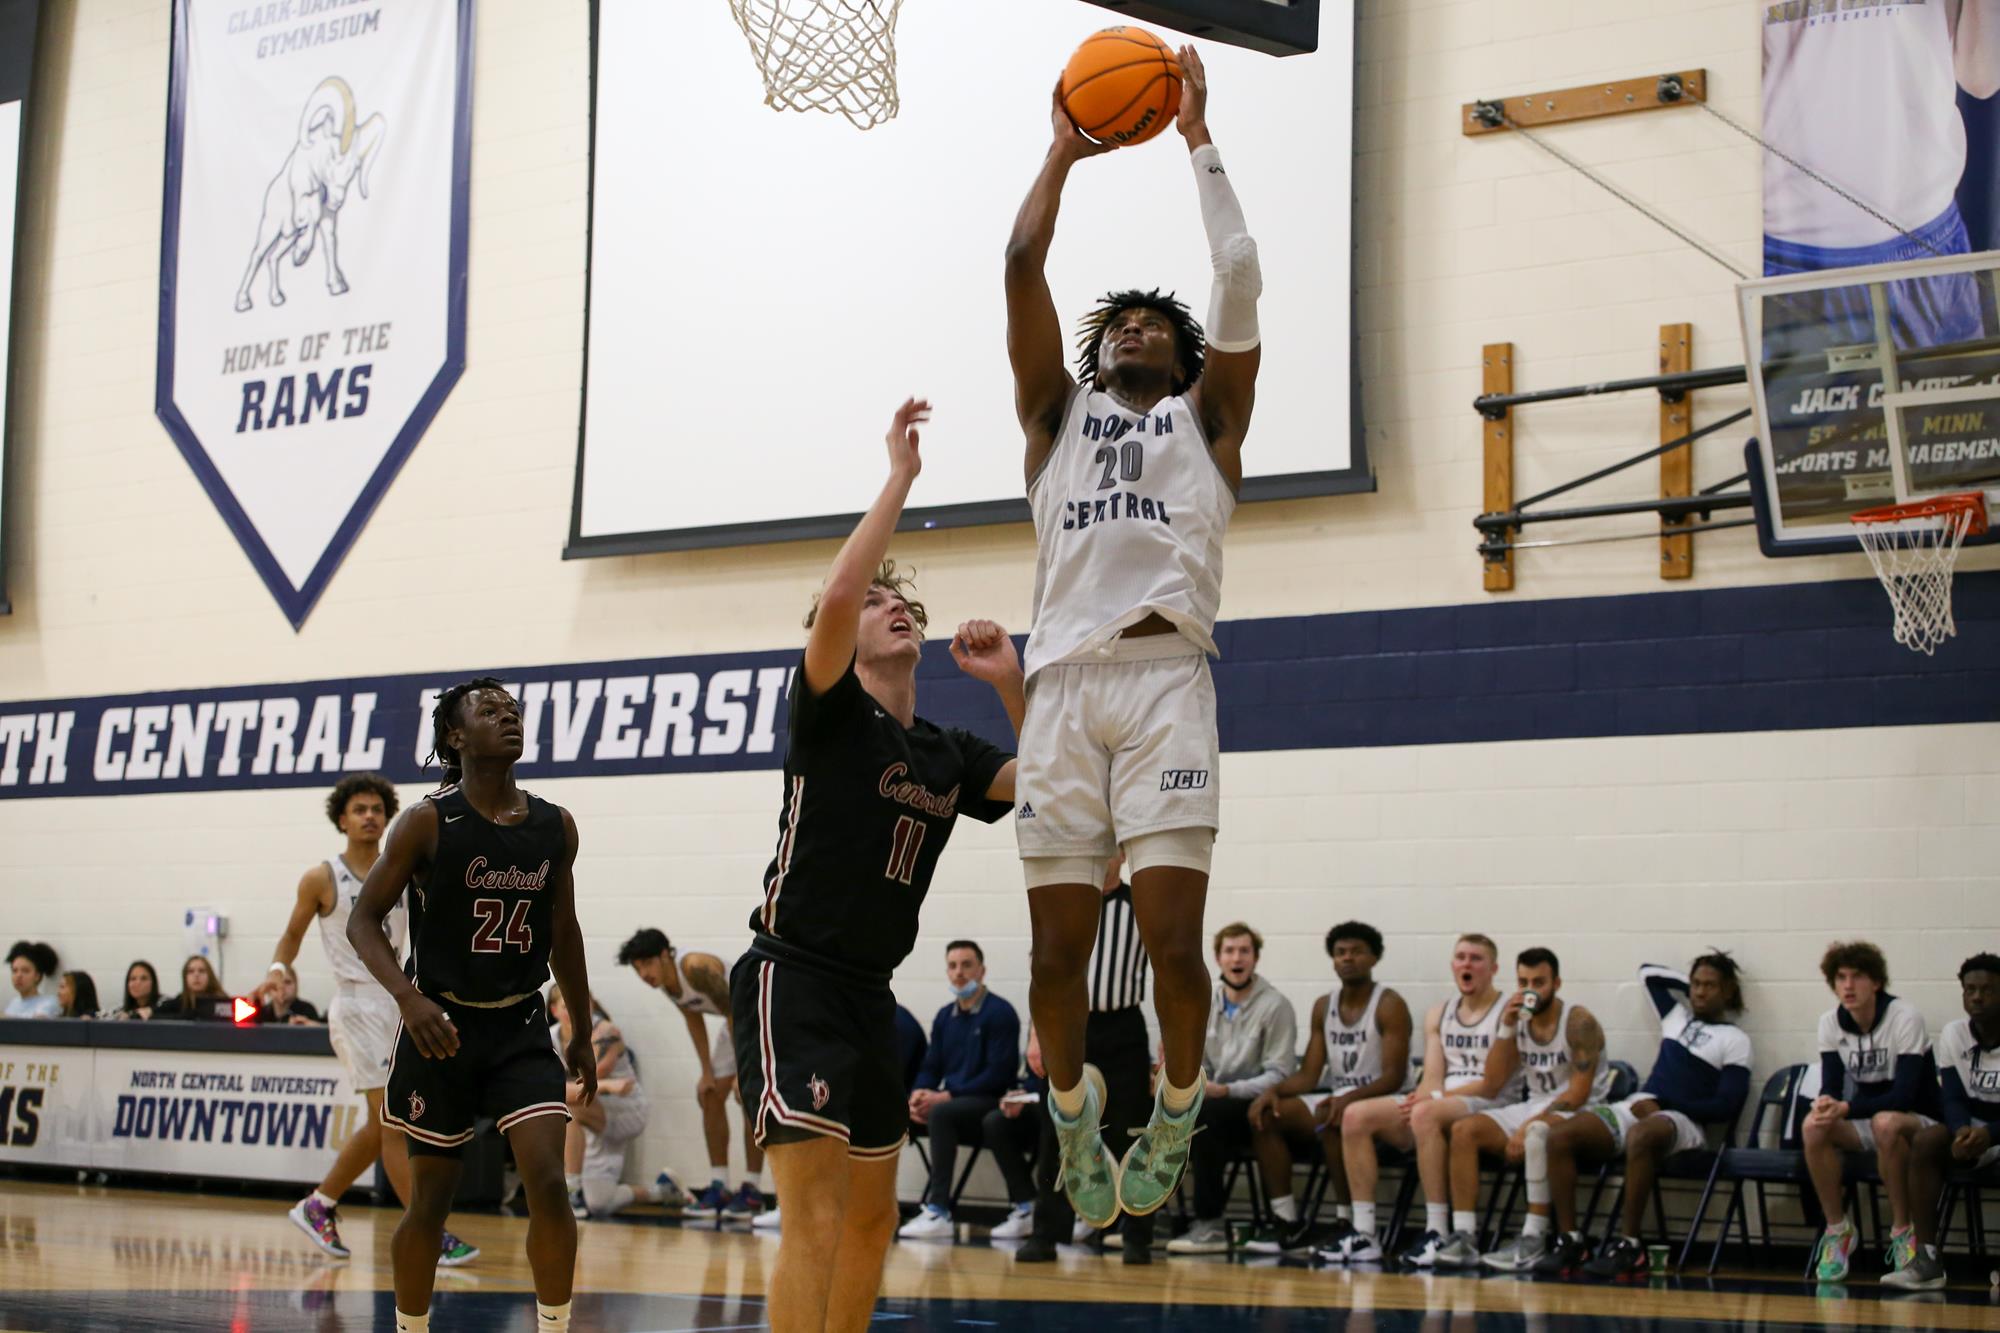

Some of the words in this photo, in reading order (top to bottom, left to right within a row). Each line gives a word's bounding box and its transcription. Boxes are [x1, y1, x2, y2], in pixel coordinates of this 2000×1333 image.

[256, 8, 381, 60] GYMNASIUM
[222, 338, 289, 375] HOME
[299, 331, 330, 362] OF
[343, 321, 391, 356] THE
[236, 364, 373, 434] RAMS
[1791, 384, 1860, 414] JACK
[1082, 411, 1174, 442] NORTH
[1921, 411, 1987, 435] MINN.
[1095, 440, 1144, 491] 20
[1063, 492, 1171, 530] CENTRAL
[93, 693, 386, 782] CENTRAL
[879, 762, 960, 818] Central
[1160, 769, 1208, 791] NCU
[885, 815, 926, 885] 11
[465, 856, 550, 891] Central
[471, 898, 533, 953] 24
[26, 1063, 60, 1083] THE
[130, 1070, 176, 1090] NORTH
[181, 1072, 244, 1092] CENTRAL
[251, 1075, 339, 1097] UNIVERSITY
